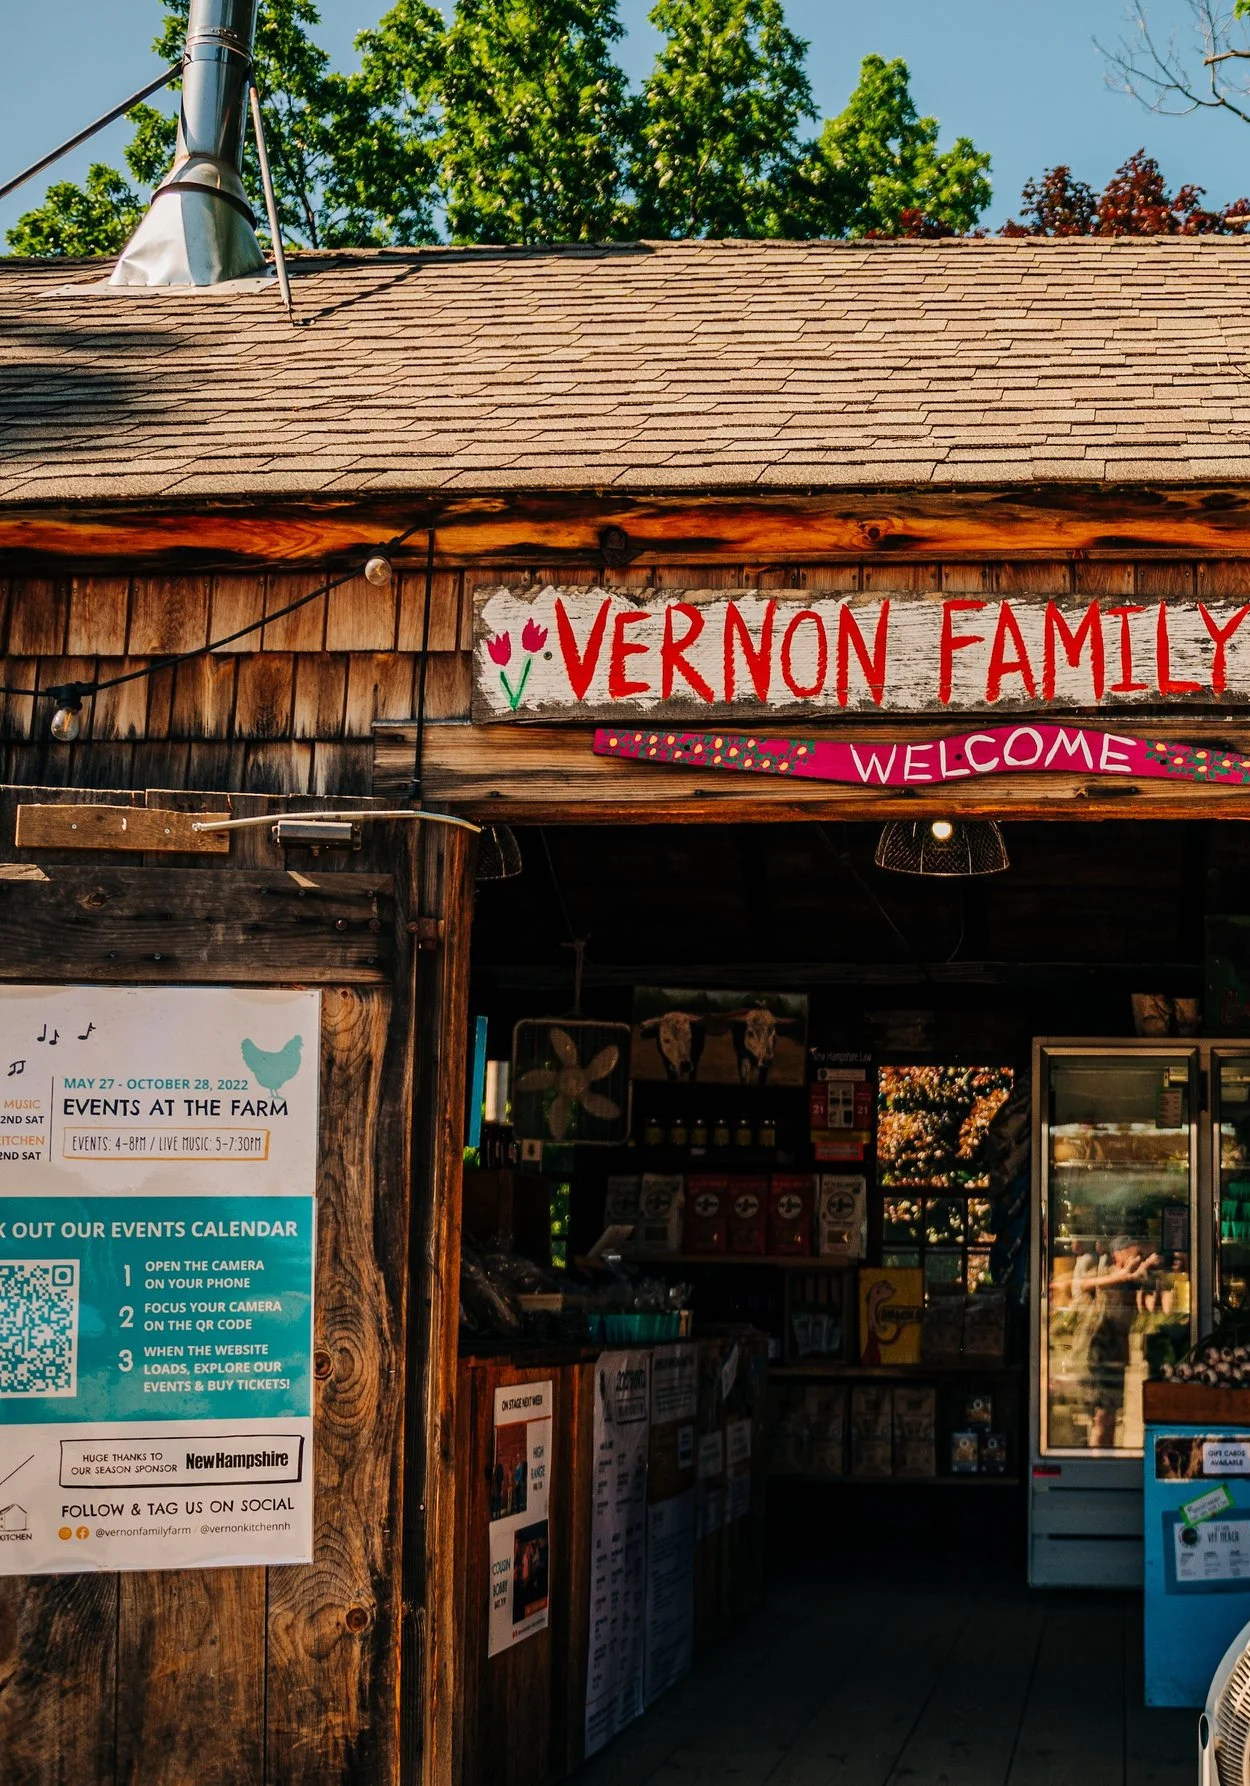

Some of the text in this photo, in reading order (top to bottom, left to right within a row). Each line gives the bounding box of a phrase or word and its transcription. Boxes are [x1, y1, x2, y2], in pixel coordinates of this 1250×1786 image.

[554, 598, 891, 708] VERNON
[850, 726, 1137, 785] WELCOME
[813, 1051, 873, 1064] New Hampshire Law
[64, 1078, 249, 1092] MAY 27 OCTOBER 28, 2022
[3, 1099, 41, 1109] MUSIC
[63, 1098, 289, 1117] EVENTS AT THE FARM
[812, 1104, 824, 1114] 21
[857, 1105, 869, 1115] 21
[0, 1115, 45, 1124] 2ND SAT
[72, 1135, 262, 1151] EVENTS: 4-8PM LIVE MUSIC: 5-7:30PM
[22, 1151, 41, 1160] SAT
[12, 1222, 55, 1239] OUT
[61, 1222, 106, 1238] OUR
[111, 1221, 186, 1238] EVENTS
[191, 1220, 298, 1237] CALENDAR
[123, 1259, 265, 1287] 1 OPEN THE CAMERA
[145, 1277, 251, 1289] ON YOUR PHONE
[118, 1301, 282, 1328] 2 FOCUS YOUR CAMERA
[144, 1319, 252, 1332] ON THE QR CODE
[118, 1344, 269, 1372] 3 WHEN THE WEBSITE
[143, 1361, 282, 1377] LOADS, EXPLORE OUR
[143, 1378, 290, 1393] EVENTS BUY TICKETS!
[502, 1395, 543, 1411] ON STAGE NEXT WEEK
[82, 1452, 163, 1463] HUGE THANKS TO
[185, 1451, 289, 1471] NewHampshire
[71, 1464, 178, 1476] OUR SEASON SPONSOR
[61, 1498, 295, 1518] FOLLOW TAG US ON SOCIAL
[95, 1522, 291, 1539] @vernonfamilyfarm @vernonkitchennh
